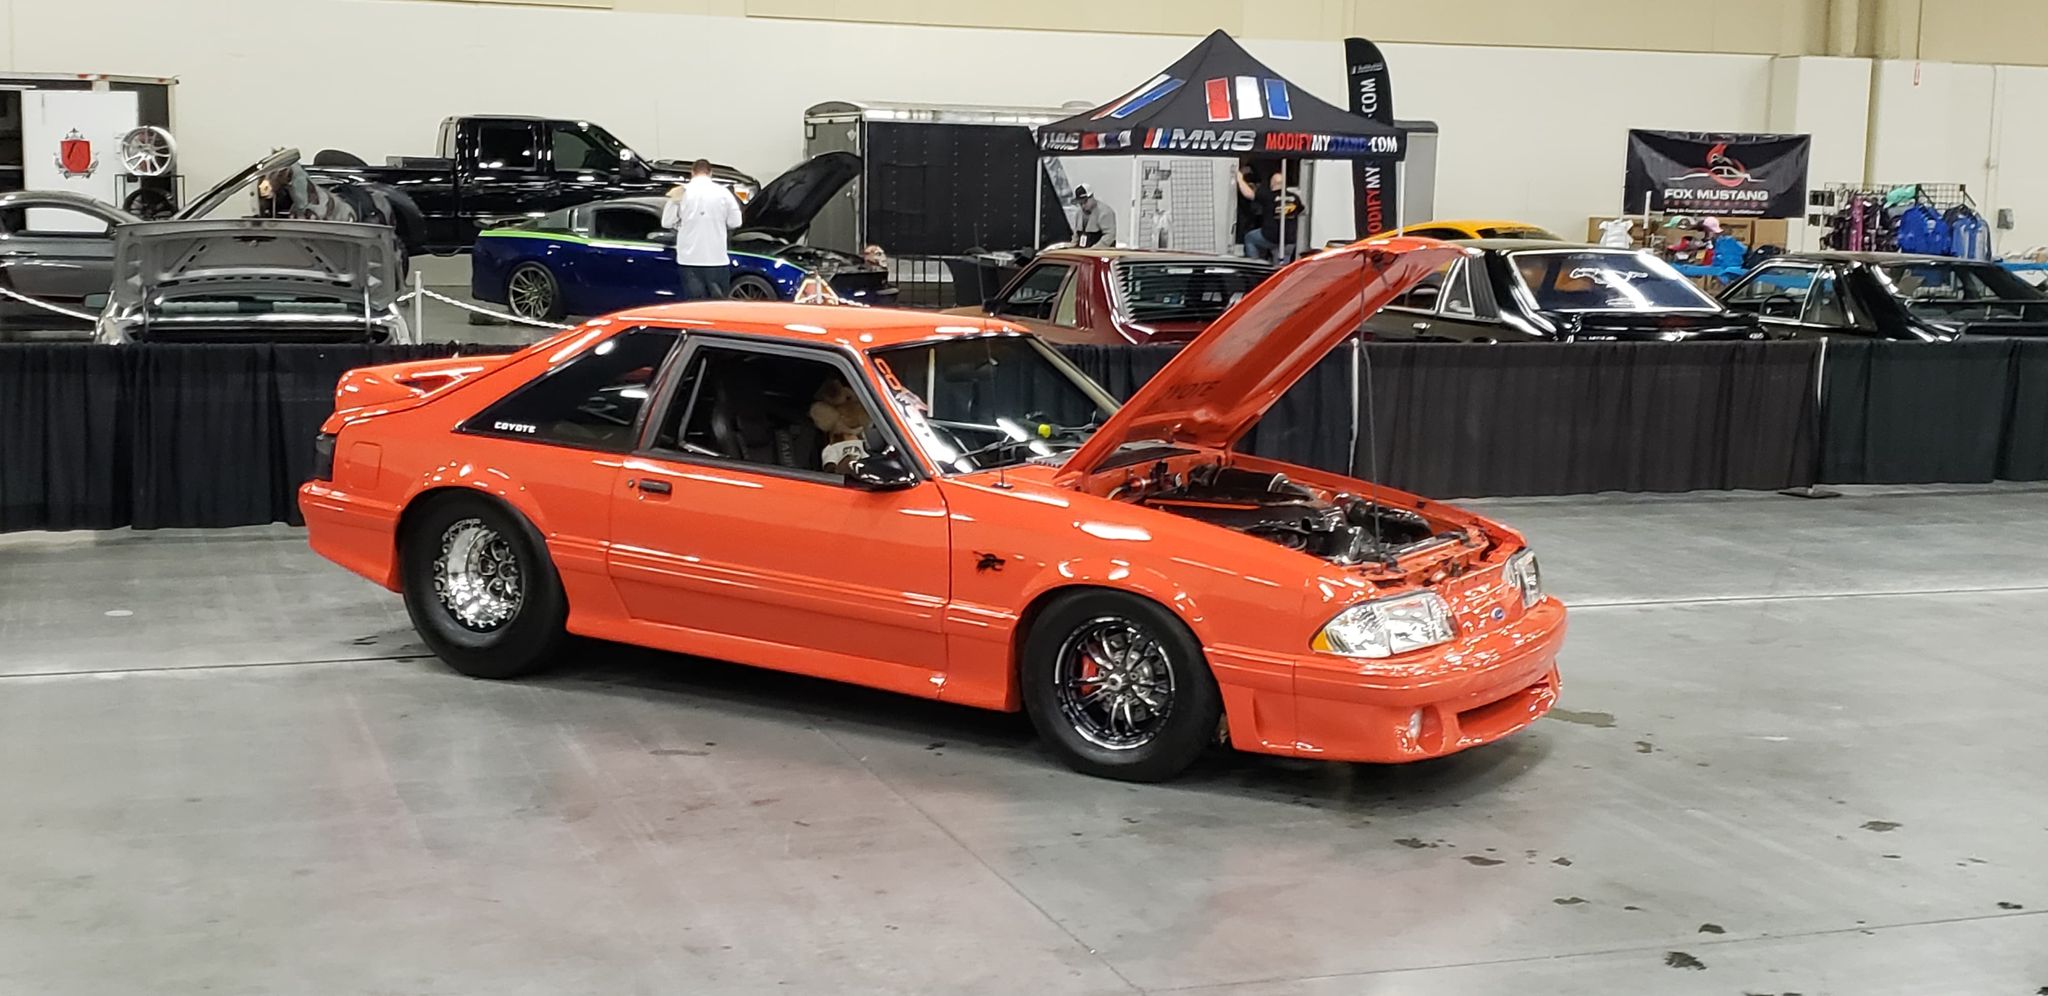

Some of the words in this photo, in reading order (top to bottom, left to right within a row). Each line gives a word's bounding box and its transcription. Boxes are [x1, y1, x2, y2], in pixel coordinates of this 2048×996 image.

[1169, 128, 1256, 151] MMS
[1664, 189, 1693, 199] FOX
[1696, 190, 1769, 201] MUSTANG
[494, 421, 536, 433] COYOTE
